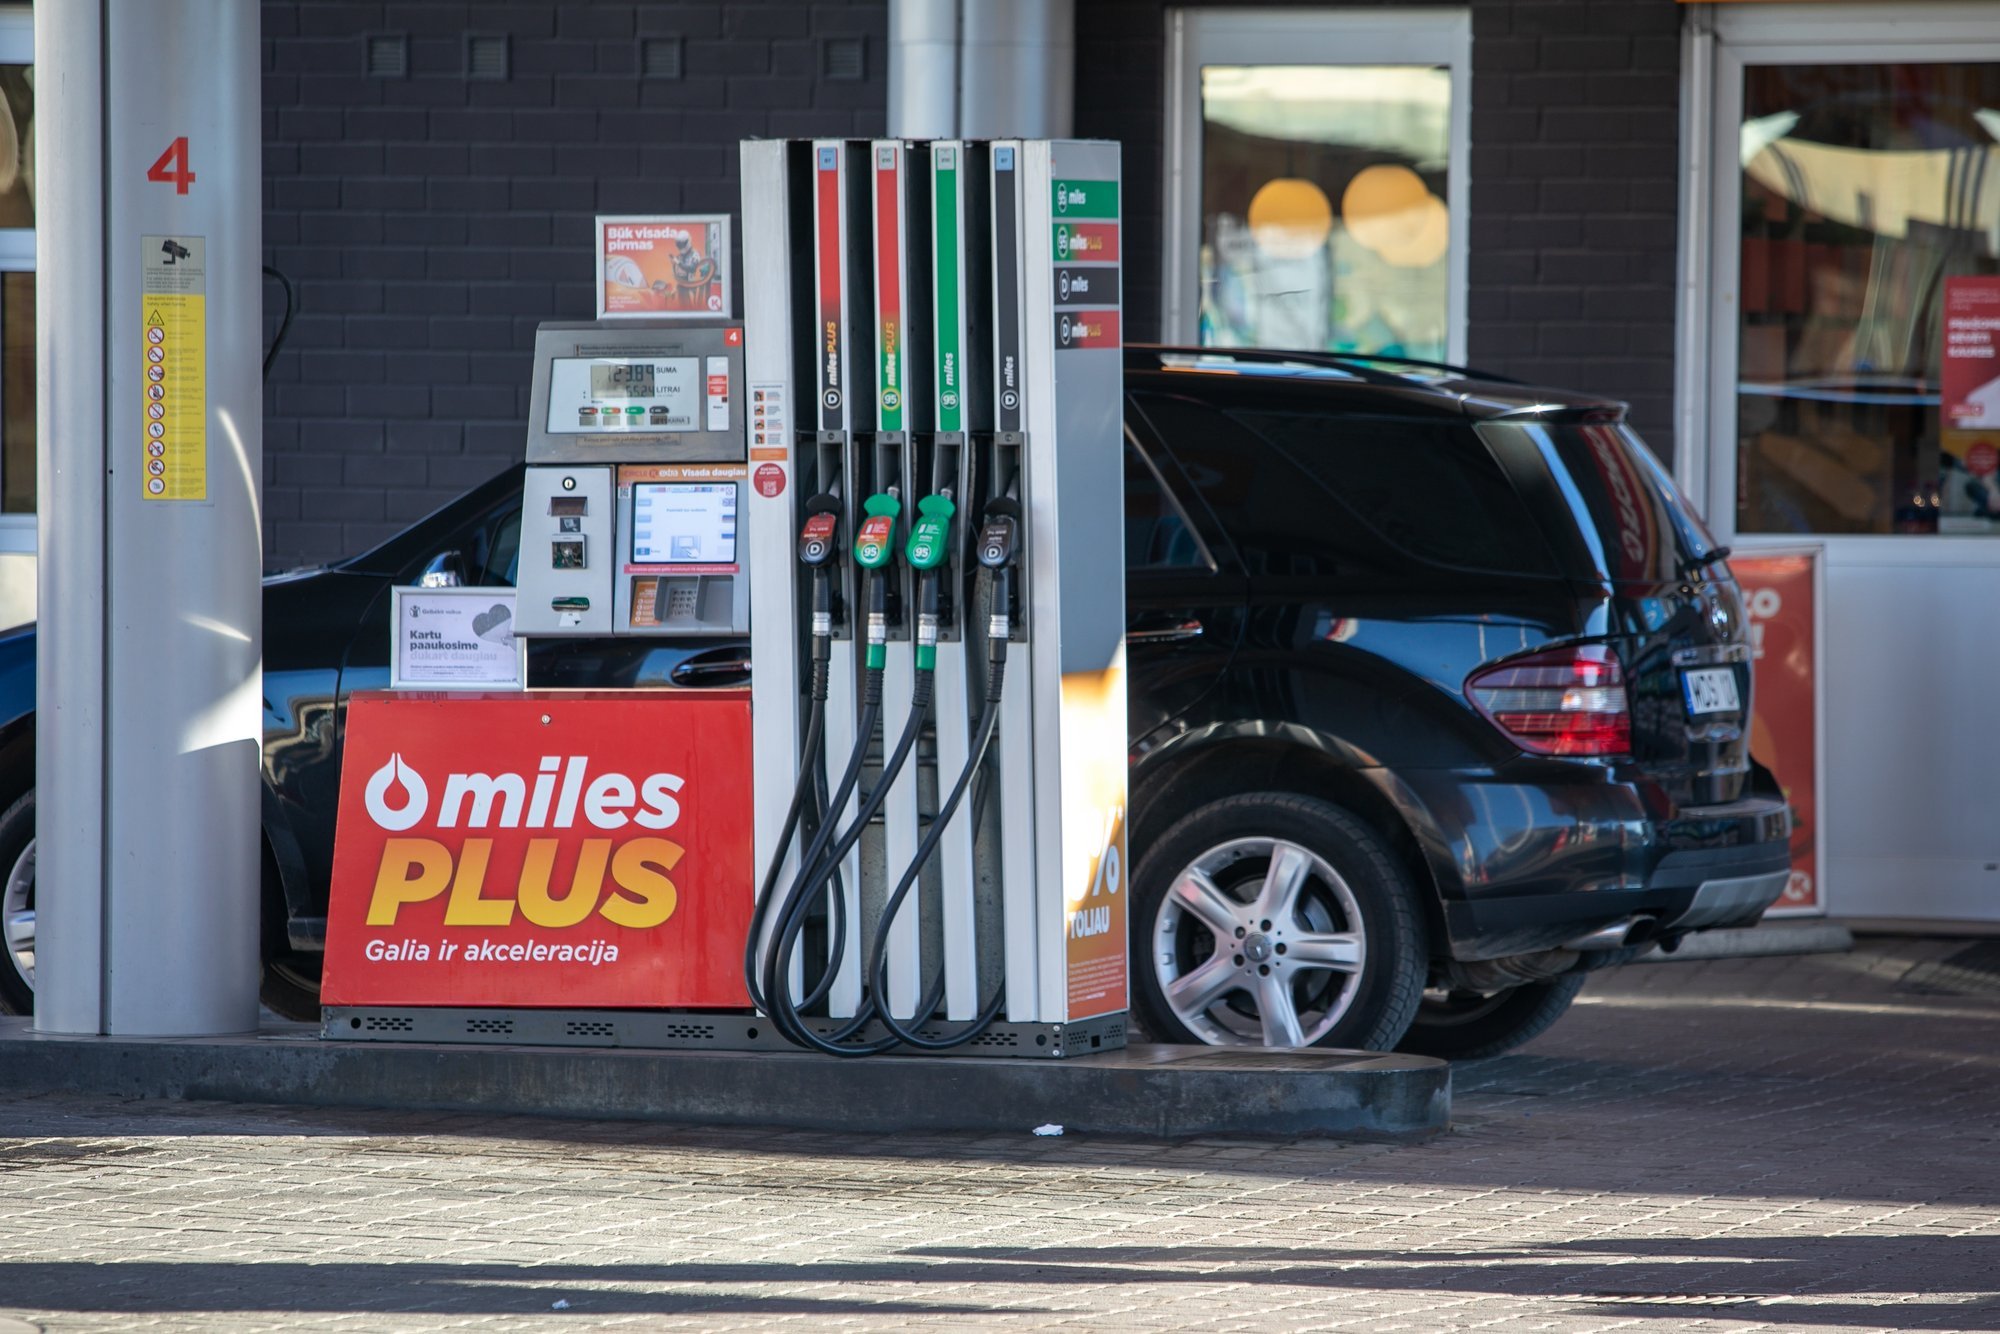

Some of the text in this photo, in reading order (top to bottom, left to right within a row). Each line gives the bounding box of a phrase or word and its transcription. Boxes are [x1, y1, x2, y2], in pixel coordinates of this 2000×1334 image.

[147, 136, 195, 195] 4
[1057, 188, 1086, 205] 95 miles
[608, 226, 677, 239] Būk visada
[608, 240, 653, 252] pirmas
[1058, 234, 1068, 249] 95
[1061, 276, 1088, 292] D miles
[1062, 323, 1069, 337] D
[729, 332, 738, 342] 4
[944, 352, 954, 386] miles
[1004, 356, 1014, 387] miles
[828, 394, 838, 404] D
[884, 394, 897, 404] 95
[942, 394, 956, 405] 95
[1005, 394, 1015, 405] D
[682, 469, 711, 477] Visada
[712, 468, 746, 478] daugiau
[810, 544, 820, 554] D
[863, 547, 877, 557] 95
[915, 547, 929, 558] 95
[988, 548, 998, 558] D
[410, 630, 441, 640] Kartu
[410, 641, 478, 652] paaukosime
[410, 651, 497, 663] dukart daugiau
[437, 756, 685, 829] miles
[366, 837, 685, 928] PLUS
[1068, 906, 1109, 939] TOLIAU
[365, 939, 619, 966] Galia ir akceleracija
